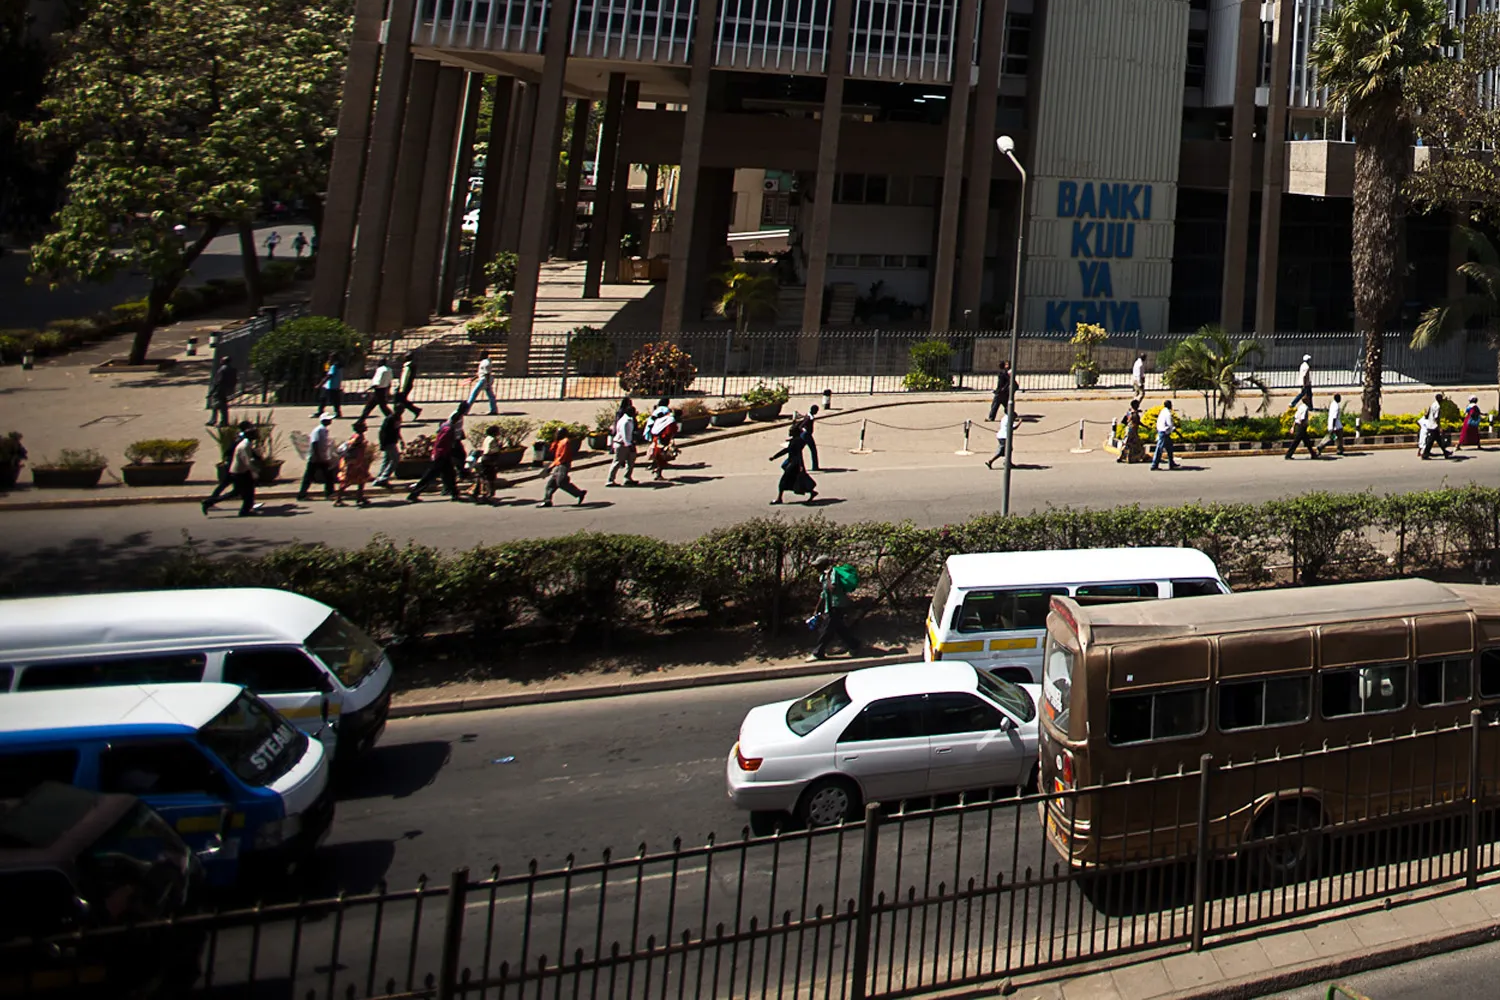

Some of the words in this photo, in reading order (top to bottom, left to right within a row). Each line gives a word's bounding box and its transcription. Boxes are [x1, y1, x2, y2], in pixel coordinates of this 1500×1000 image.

[1057, 181, 1153, 220] BANKI
[1070, 221, 1136, 258] KUU
[1079, 261, 1113, 298] YA
[1045, 301, 1142, 333] KENYA
